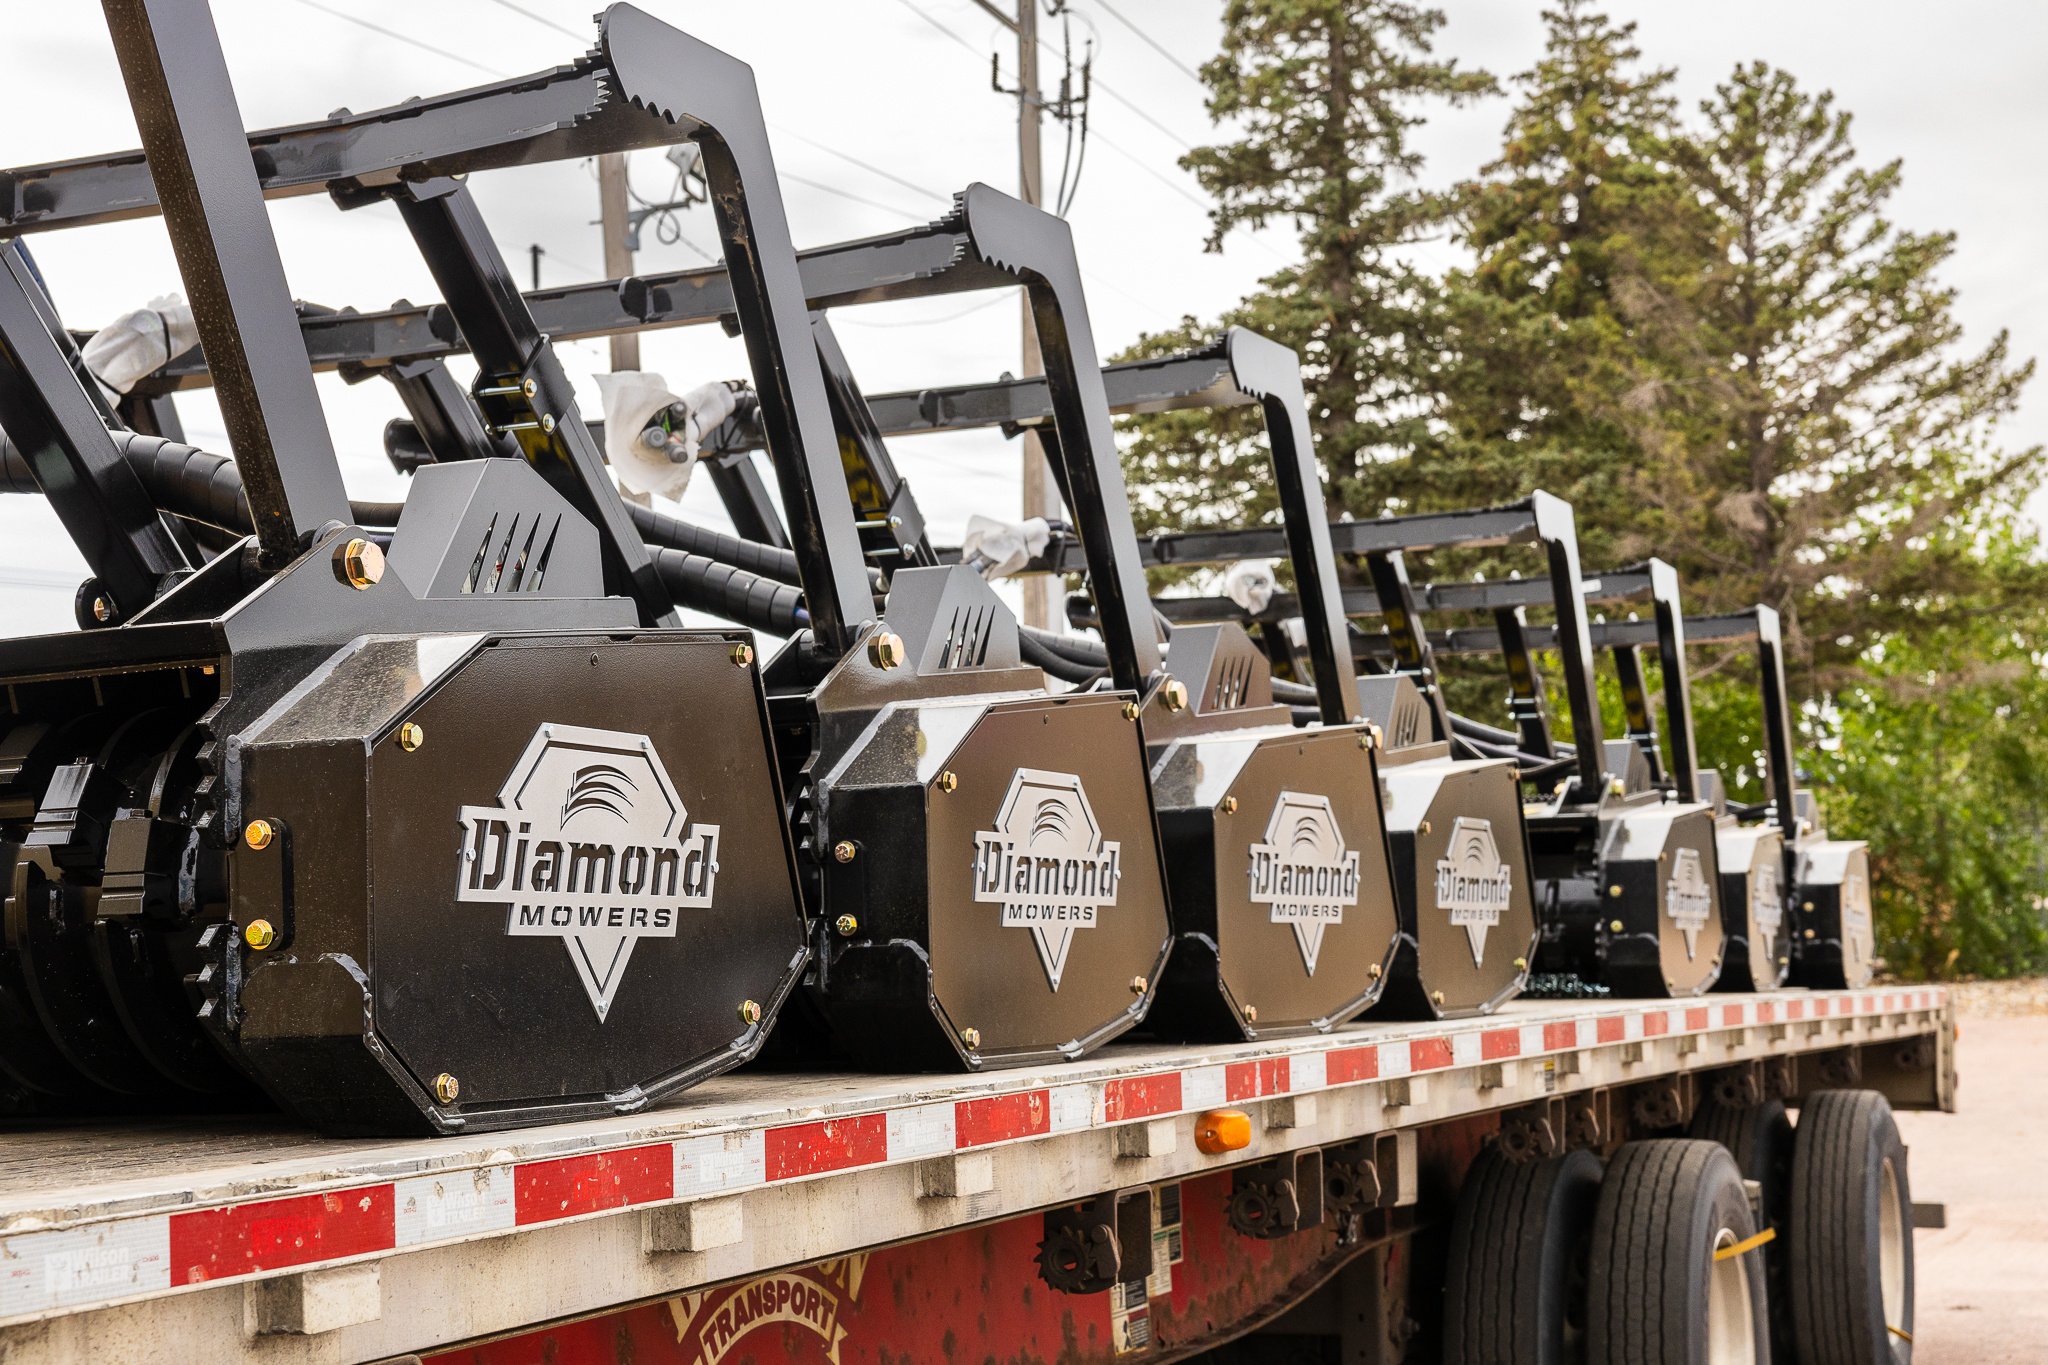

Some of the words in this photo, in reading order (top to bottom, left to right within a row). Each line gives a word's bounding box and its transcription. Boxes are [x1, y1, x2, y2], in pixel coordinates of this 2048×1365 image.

[466, 817, 715, 899] Diamond
[979, 840, 1118, 898] Diamond
[1254, 851, 1357, 898] Diamond
[1440, 866, 1508, 904] Diamond
[518, 904, 673, 929] MOWERS
[1008, 903, 1094, 921] MOWERS
[1275, 903, 1340, 917] MOWERS
[702, 1279, 836, 1360] TRANSPORT
